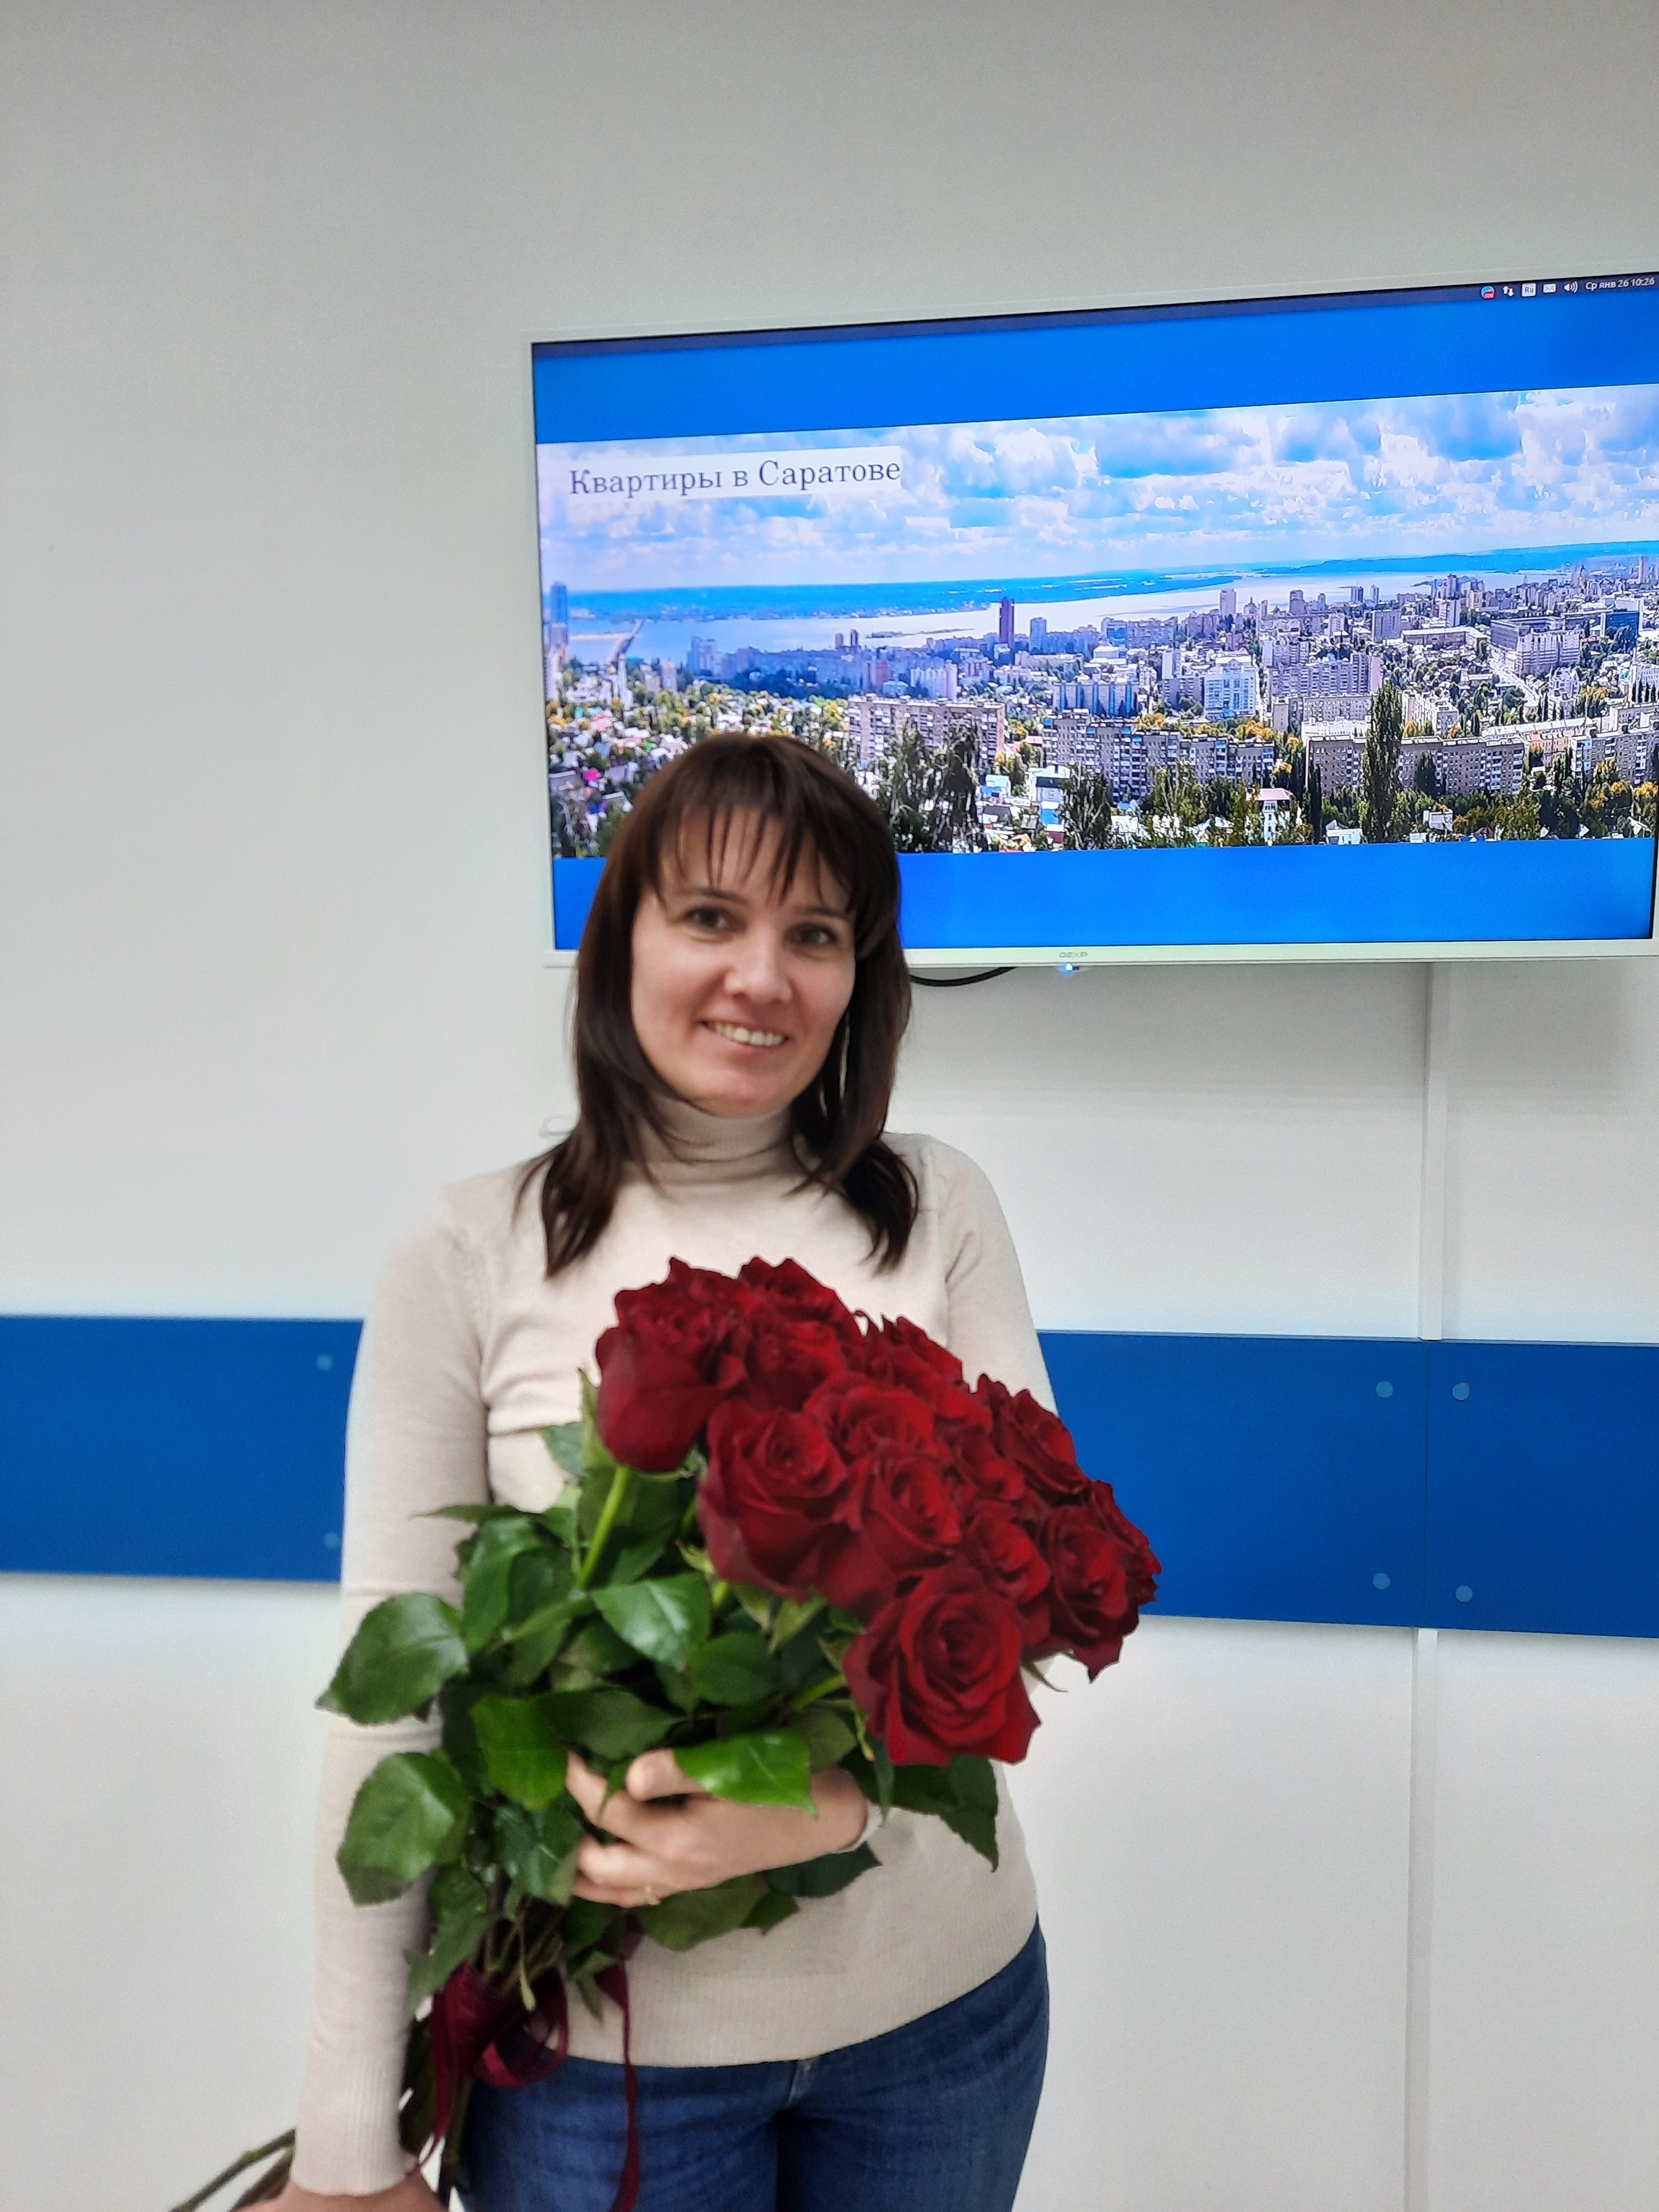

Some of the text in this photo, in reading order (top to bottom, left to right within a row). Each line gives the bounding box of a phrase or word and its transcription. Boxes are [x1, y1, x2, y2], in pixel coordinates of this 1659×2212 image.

[1585, 282, 1597, 291] Ср
[1618, 279, 1629, 288] 26
[1630, 277, 1655, 286] 10:26
[570, 460, 901, 498] Квартиры в Саратове
